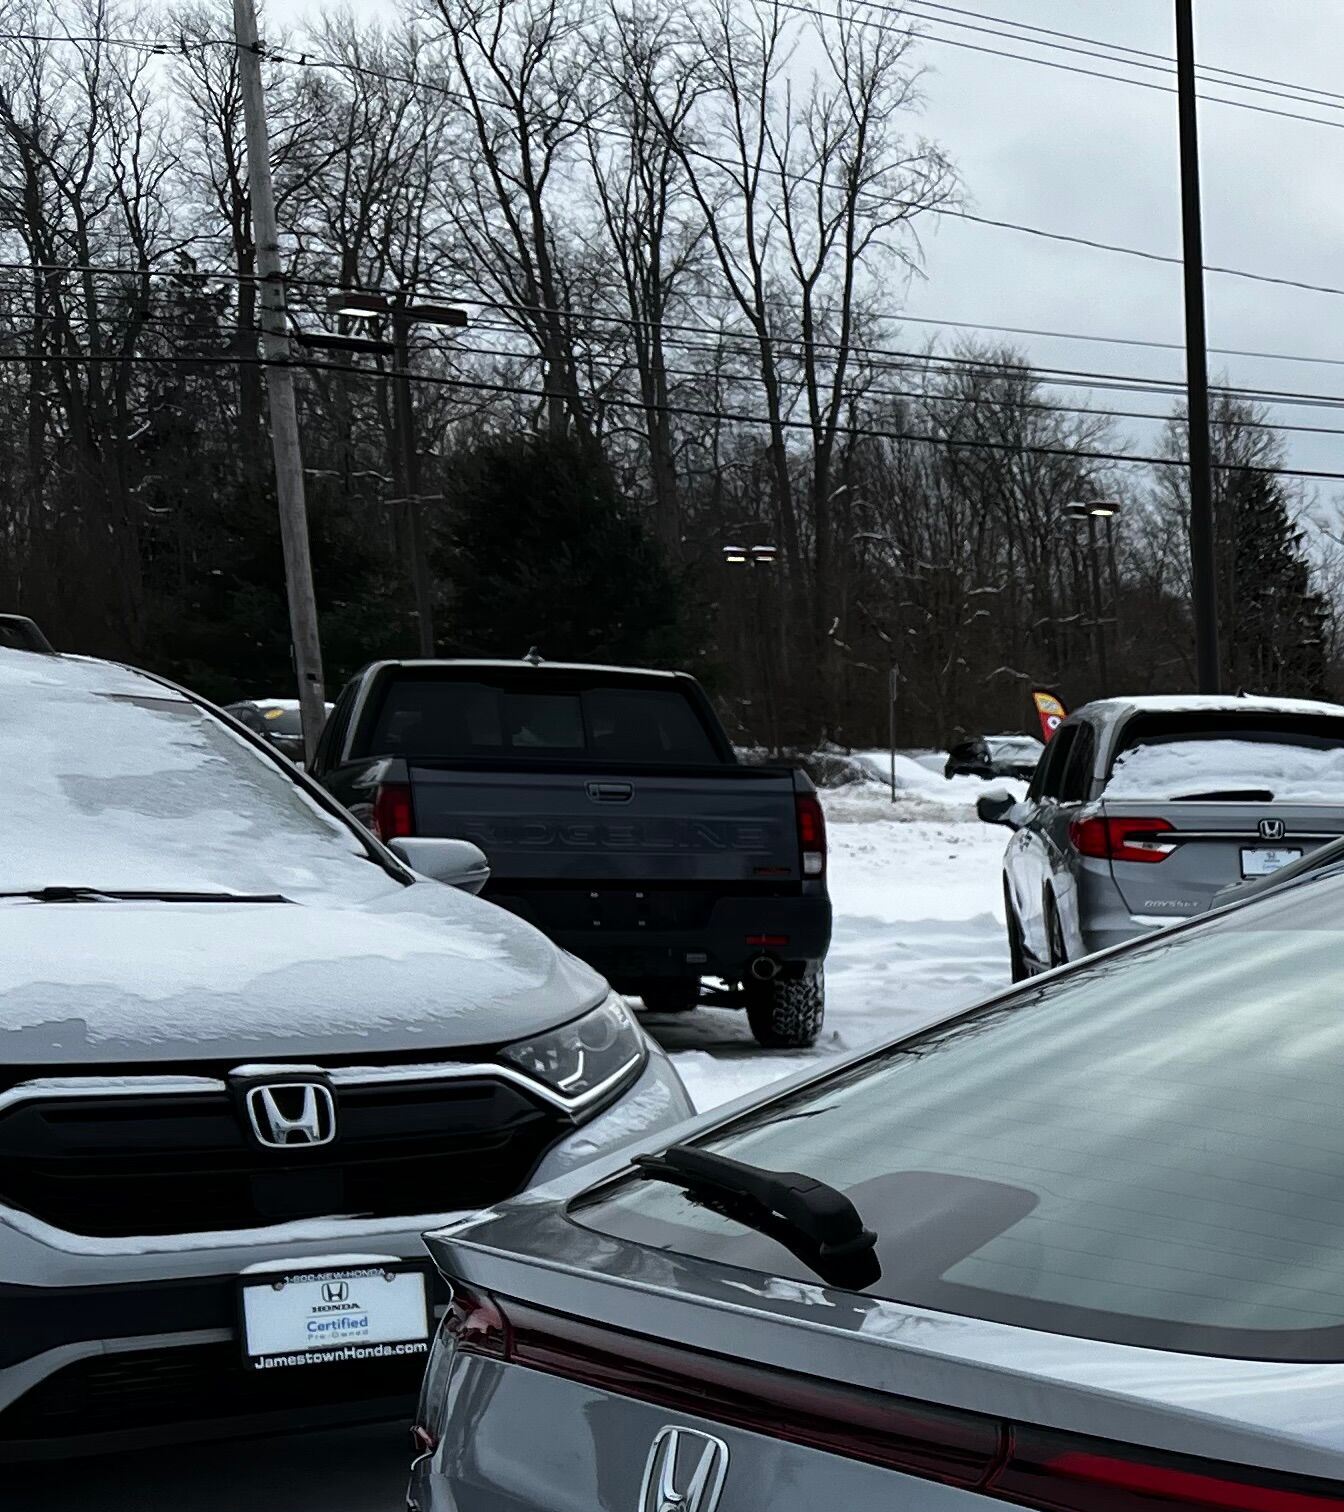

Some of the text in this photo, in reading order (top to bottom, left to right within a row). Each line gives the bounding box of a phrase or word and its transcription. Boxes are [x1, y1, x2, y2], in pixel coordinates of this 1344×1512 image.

[463, 820, 769, 849] RIDGELINE
[312, 1303, 361, 1313] HONDA
[307, 1316, 369, 1333] Certified
[255, 1342, 428, 1369] JamestownHonda.com
